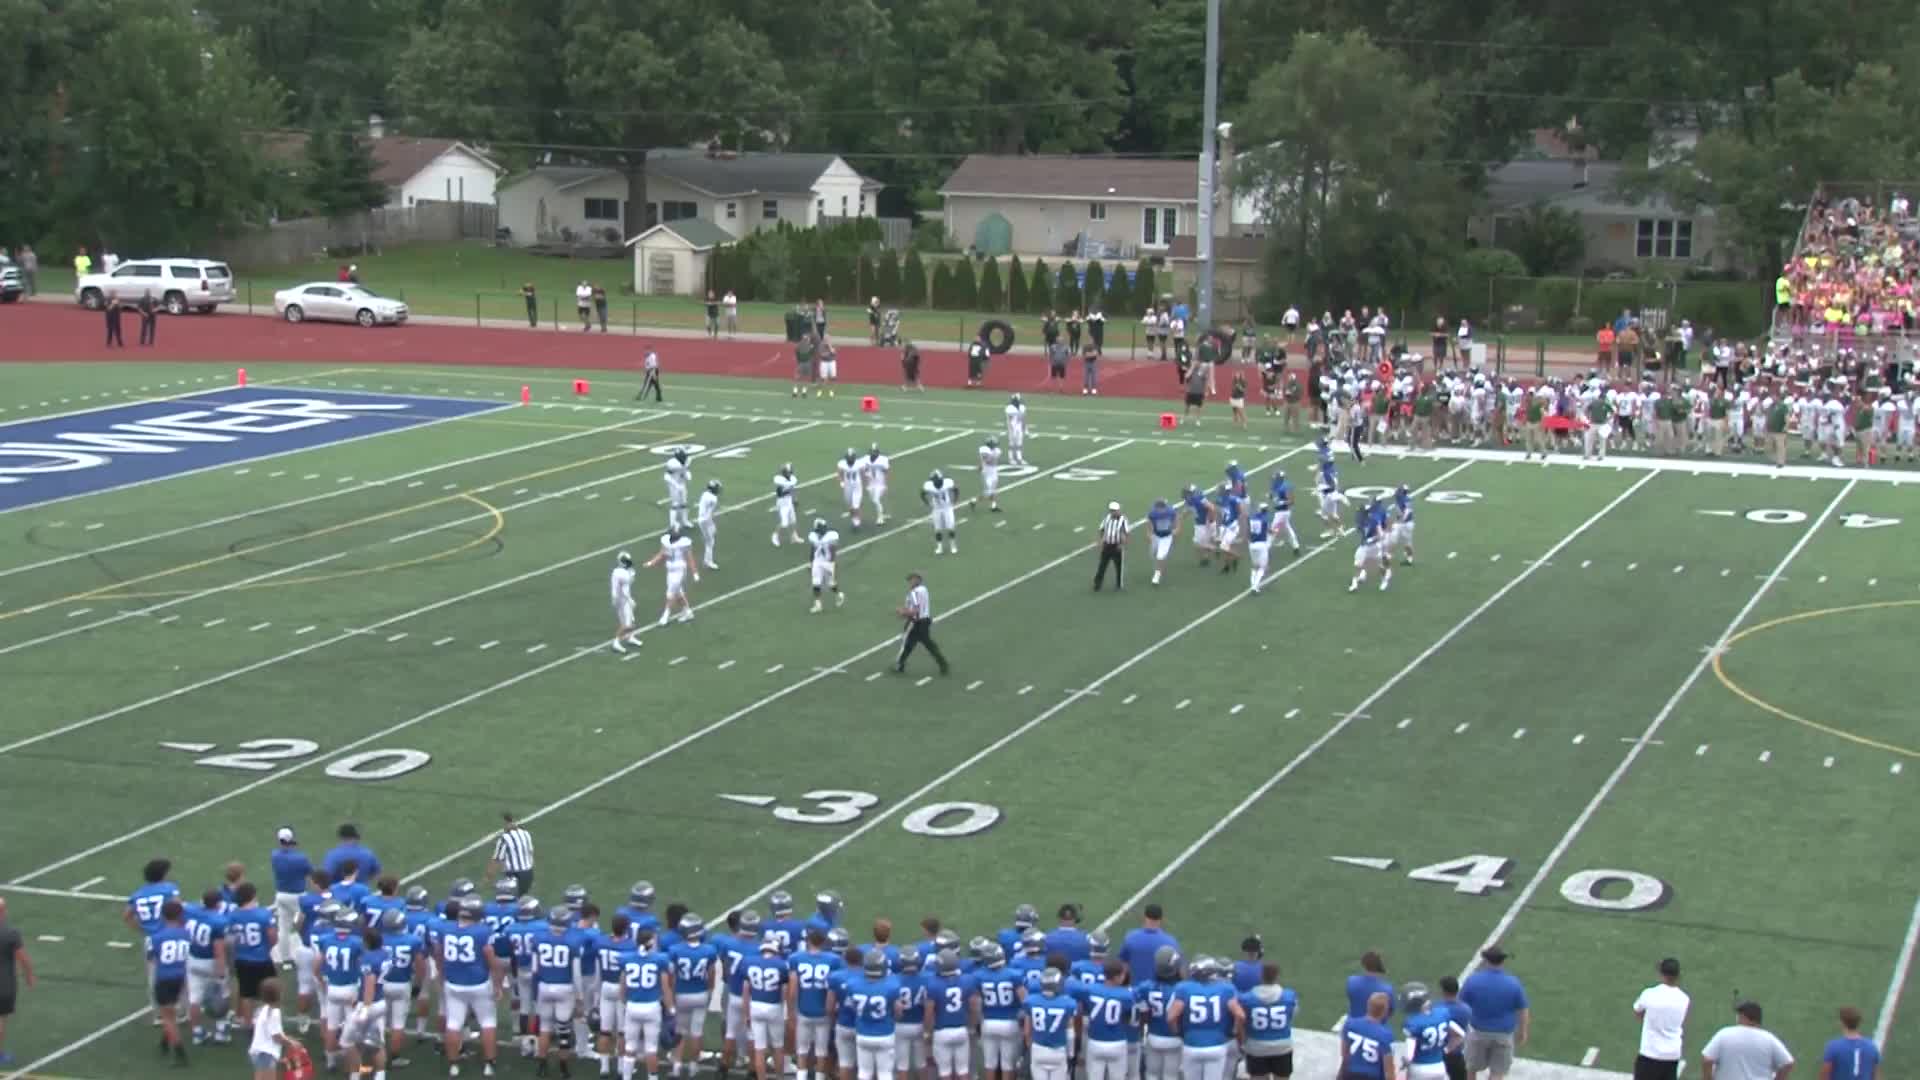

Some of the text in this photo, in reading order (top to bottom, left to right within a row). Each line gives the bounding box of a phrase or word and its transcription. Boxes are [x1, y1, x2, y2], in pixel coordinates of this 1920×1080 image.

[136, 895, 164, 921] 57
[160, 940, 190, 964] 80
[443, 934, 476, 963] 63
[538, 943, 570, 968] 20
[625, 962, 658, 988] 26
[747, 966, 780, 991] 82
[852, 993, 887, 1019] 73
[945, 987, 962, 1012] 3
[982, 981, 1014, 1006] 56
[1031, 1007, 1065, 1032] 87
[1089, 996, 1121, 1025] 70
[1189, 995, 1221, 1023] 51
[1251, 1006, 1287, 1030] 65
[1347, 1031, 1380, 1063] 75
